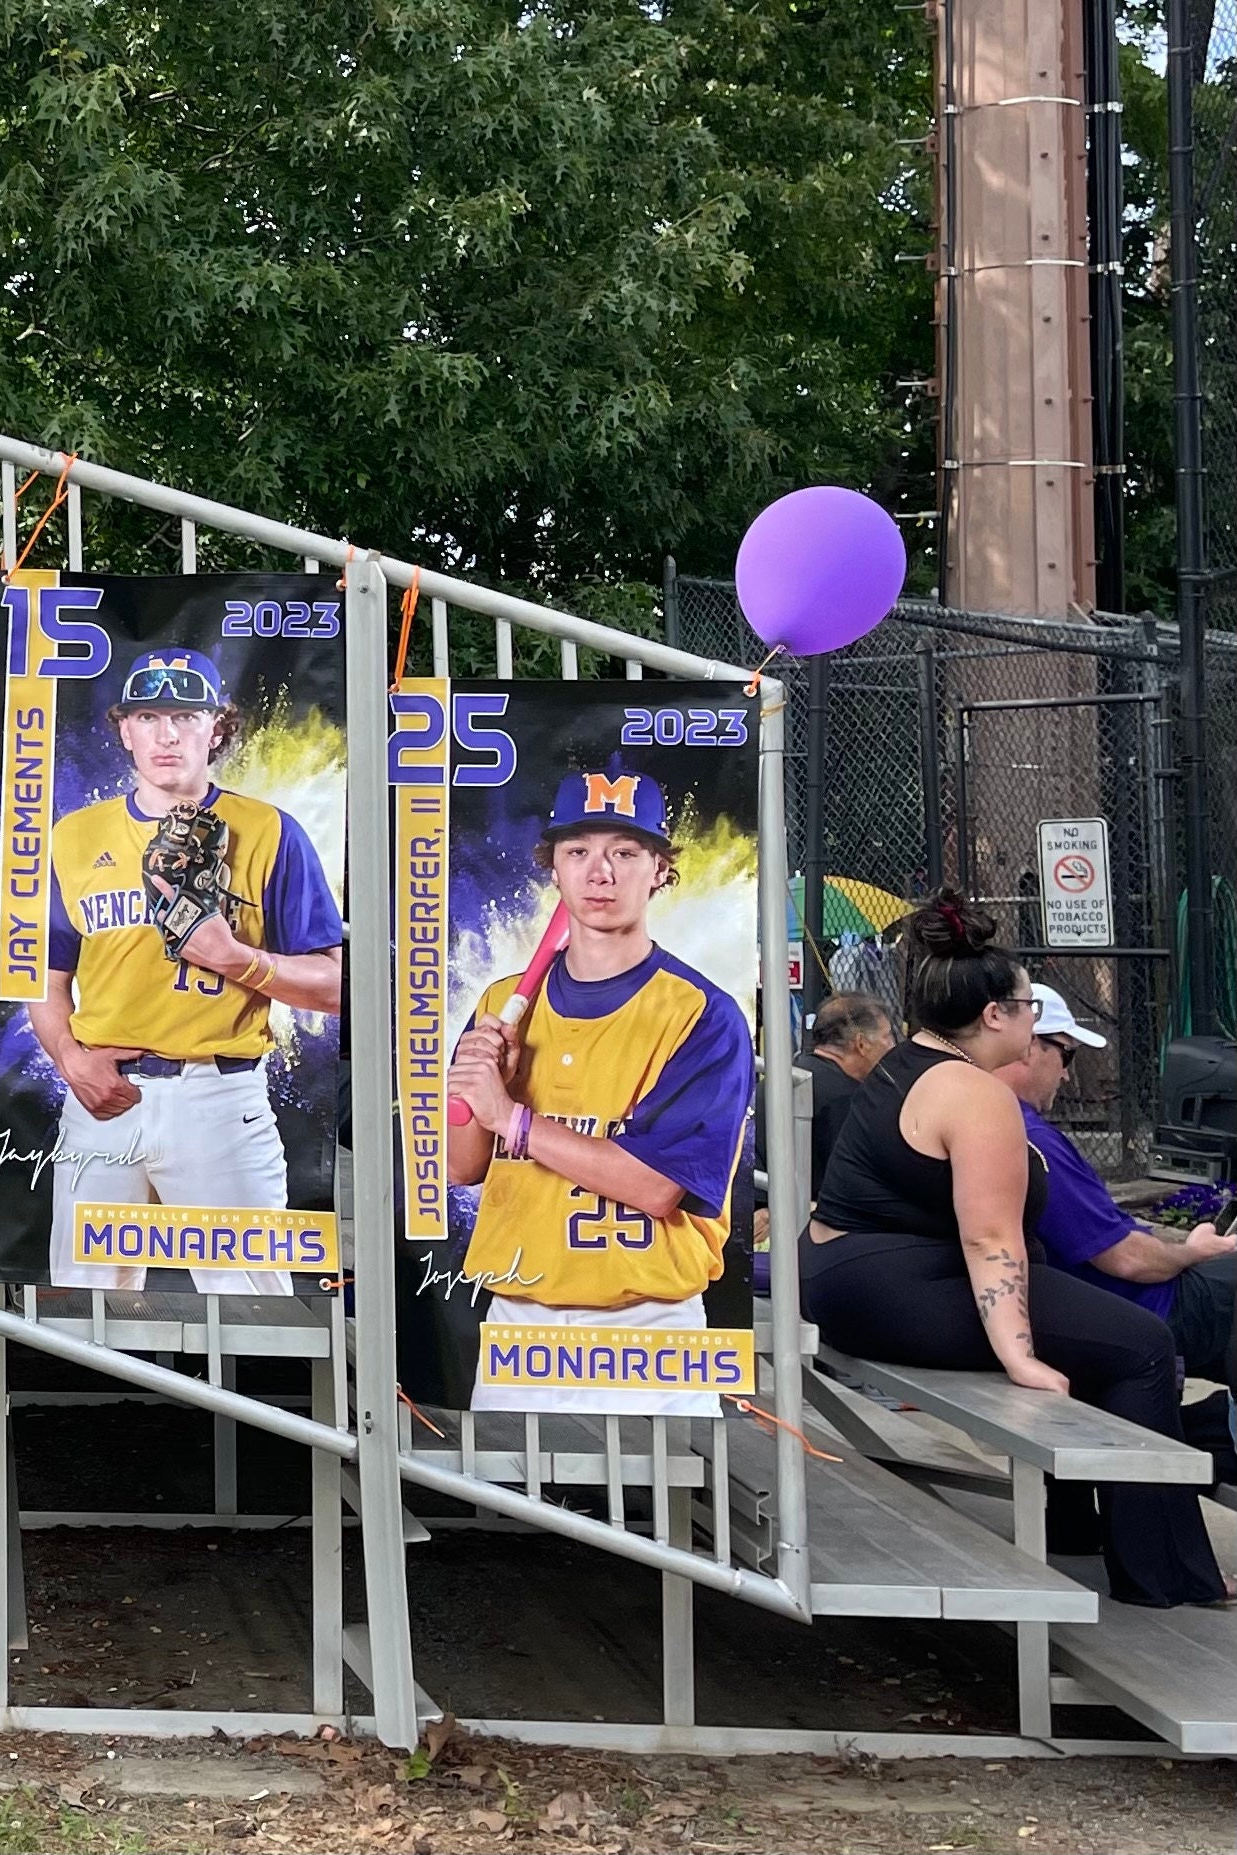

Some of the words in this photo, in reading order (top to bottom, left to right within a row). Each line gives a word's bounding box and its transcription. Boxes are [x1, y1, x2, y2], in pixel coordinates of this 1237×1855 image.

[1, 586, 112, 680] 15
[221, 600, 341, 638] 2023
[387, 693, 517, 787] 25
[620, 708, 749, 747] 2023
[11, 707, 45, 899] CLEMENTS
[410, 797, 441, 814] II
[583, 773, 641, 818] M
[1047, 841, 1098, 851] SMOKING
[1063, 827, 1079, 837] NO
[1046, 900, 1062, 909] NO
[1066, 900, 1087, 909] USE
[1091, 900, 1105, 909] OF
[1052, 912, 1103, 921] TOBACCO
[9, 912, 38, 982] JAY
[1049, 924, 1107, 934] PRODUCTS
[410, 827, 444, 1078] HELMSDERFER,
[411, 1092, 442, 1222] JOSEPH
[83, 1209, 189, 1222] MENCHVILLE
[201, 1214, 240, 1224] HIGH
[252, 1215, 317, 1226] SCHOOL
[568, 1184, 655, 1251] 25
[82, 1222, 326, 1263] MONARCHS
[415, 1246, 544, 1308] Joseph
[489, 1330, 599, 1342] MENCHVILLE
[612, 1333, 653, 1343] HIGH
[666, 1335, 733, 1346] SCHOOL
[488, 1342, 742, 1384] MONARCHS
